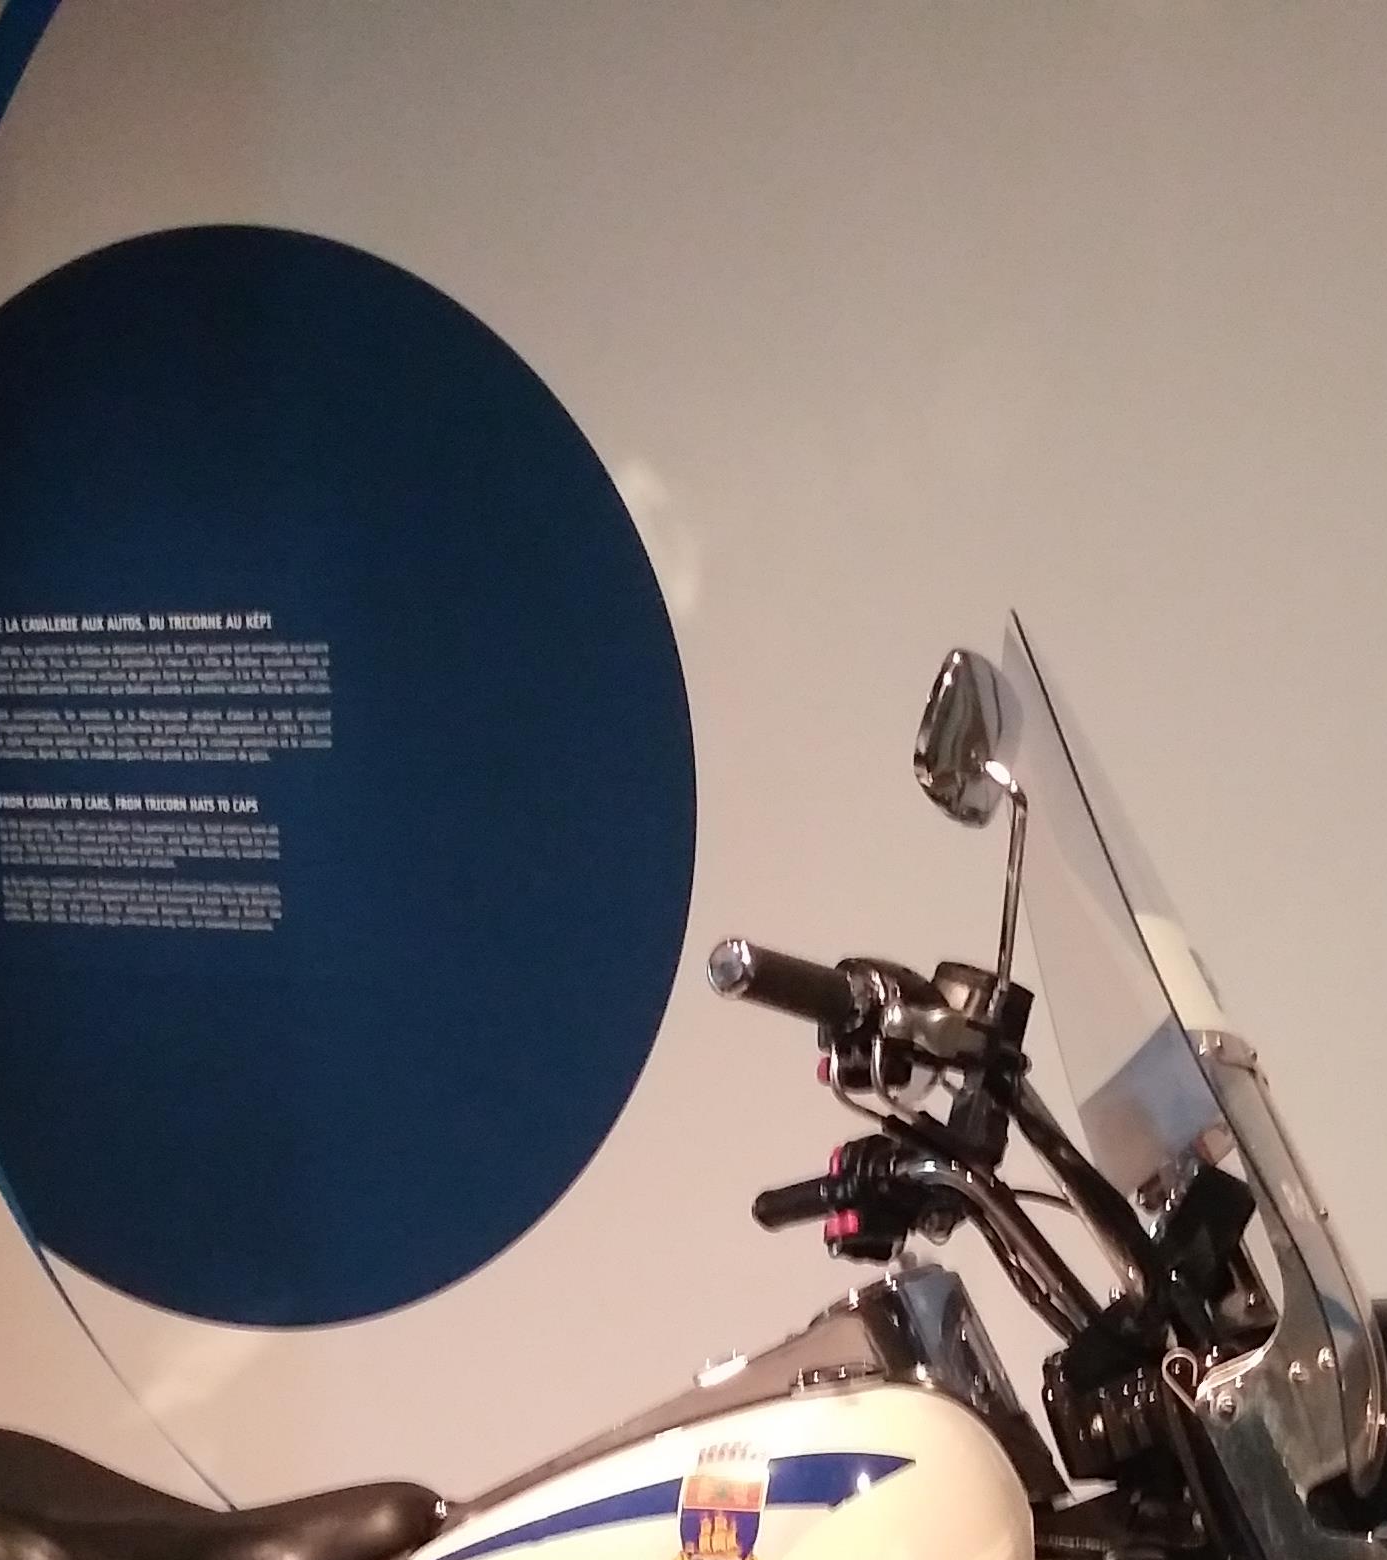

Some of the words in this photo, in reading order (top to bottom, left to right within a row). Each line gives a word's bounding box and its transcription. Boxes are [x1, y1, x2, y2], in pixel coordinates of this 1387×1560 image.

[5, 617, 19, 632] LA
[21, 615, 78, 632] CAVALERIE
[81, 615, 104, 632] AUX
[107, 615, 145, 632] AUTOS,
[149, 614, 164, 630] DU
[168, 614, 223, 630] TRICORNE
[226, 614, 242, 629] AU
[246, 611, 272, 629] KÉPI
[71, 796, 83, 810] TO
[115, 796, 142, 811] FROM
[145, 797, 186, 811] TRICORN
[190, 798, 215, 812] HATS
[218, 798, 230, 812] TO
[233, 797, 259, 813] CAPS
